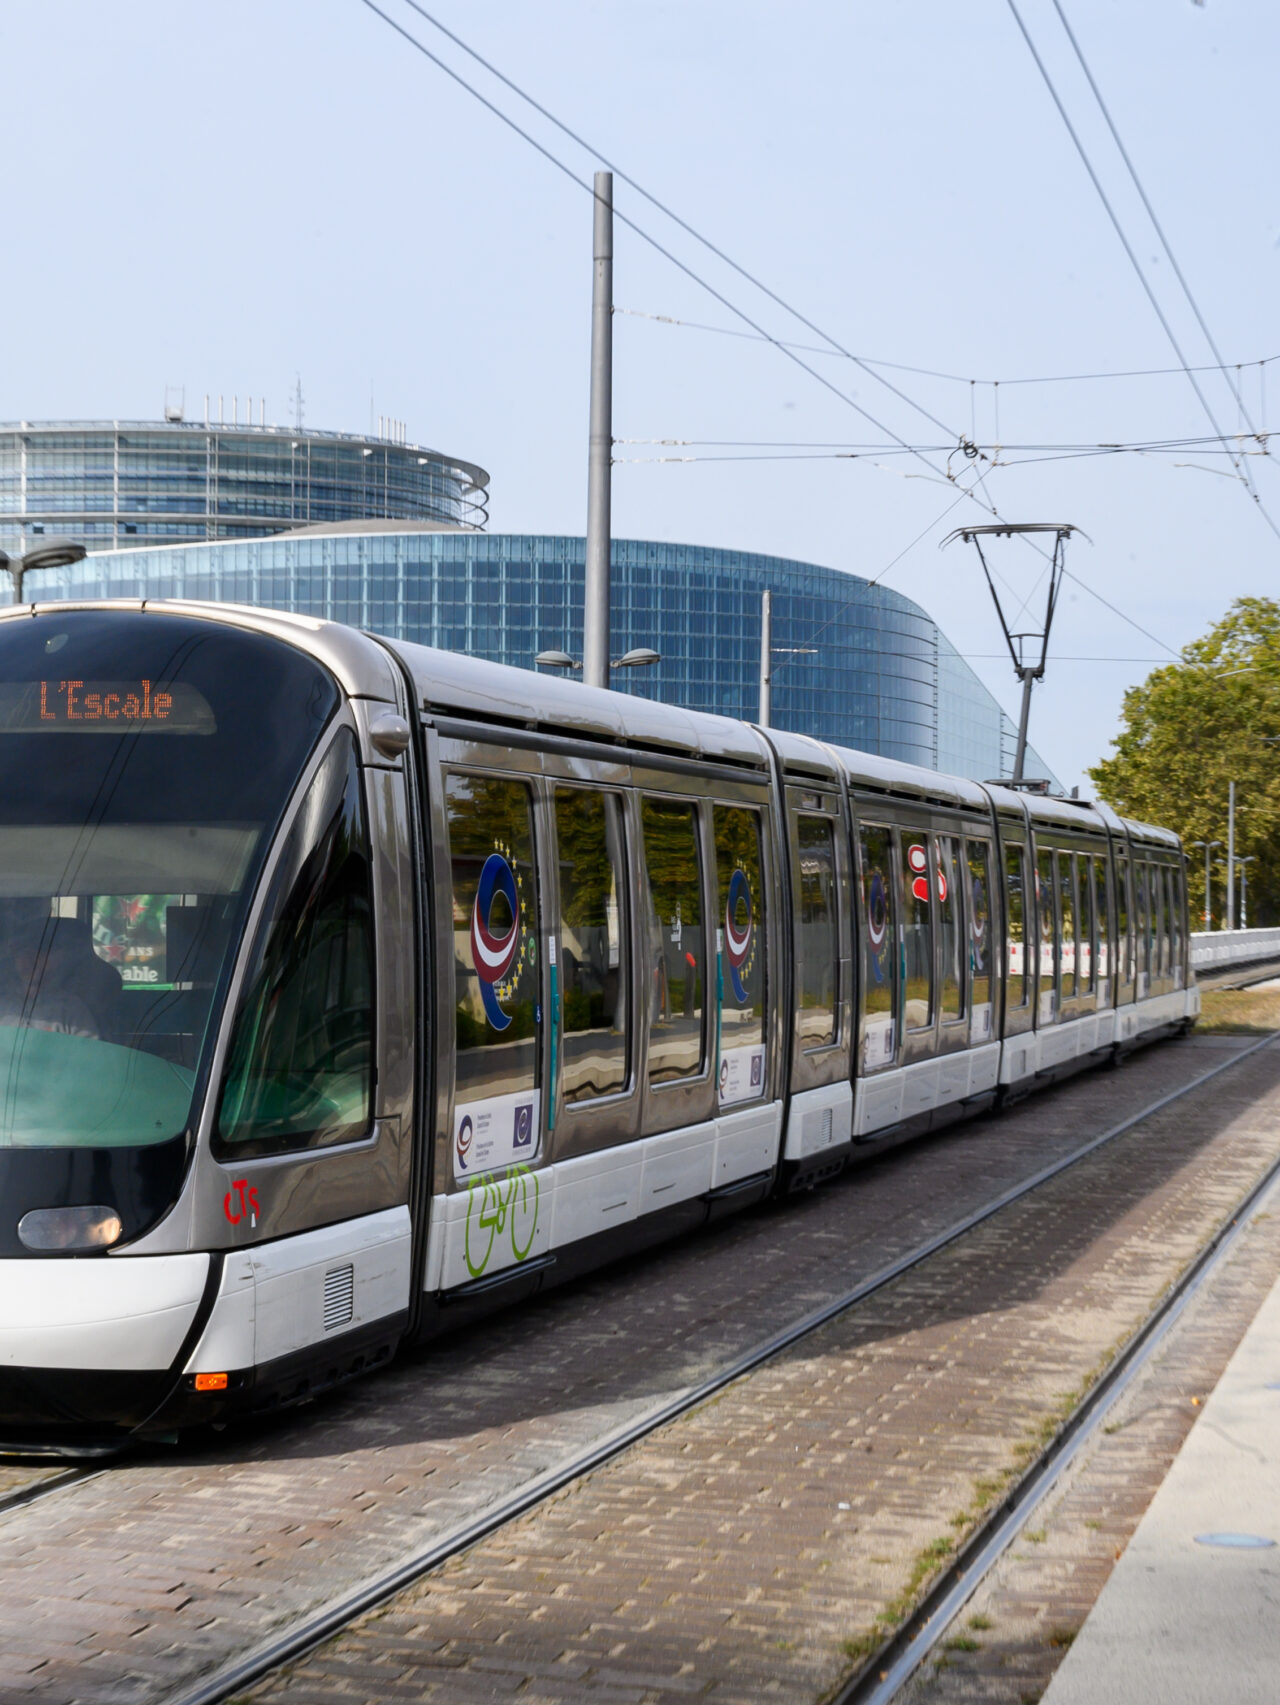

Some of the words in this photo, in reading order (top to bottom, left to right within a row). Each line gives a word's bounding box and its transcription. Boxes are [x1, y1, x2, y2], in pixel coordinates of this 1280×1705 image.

[40, 680, 173, 720] L'Escale
[127, 946, 155, 957] ANS
[223, 1179, 260, 1225] CTS
